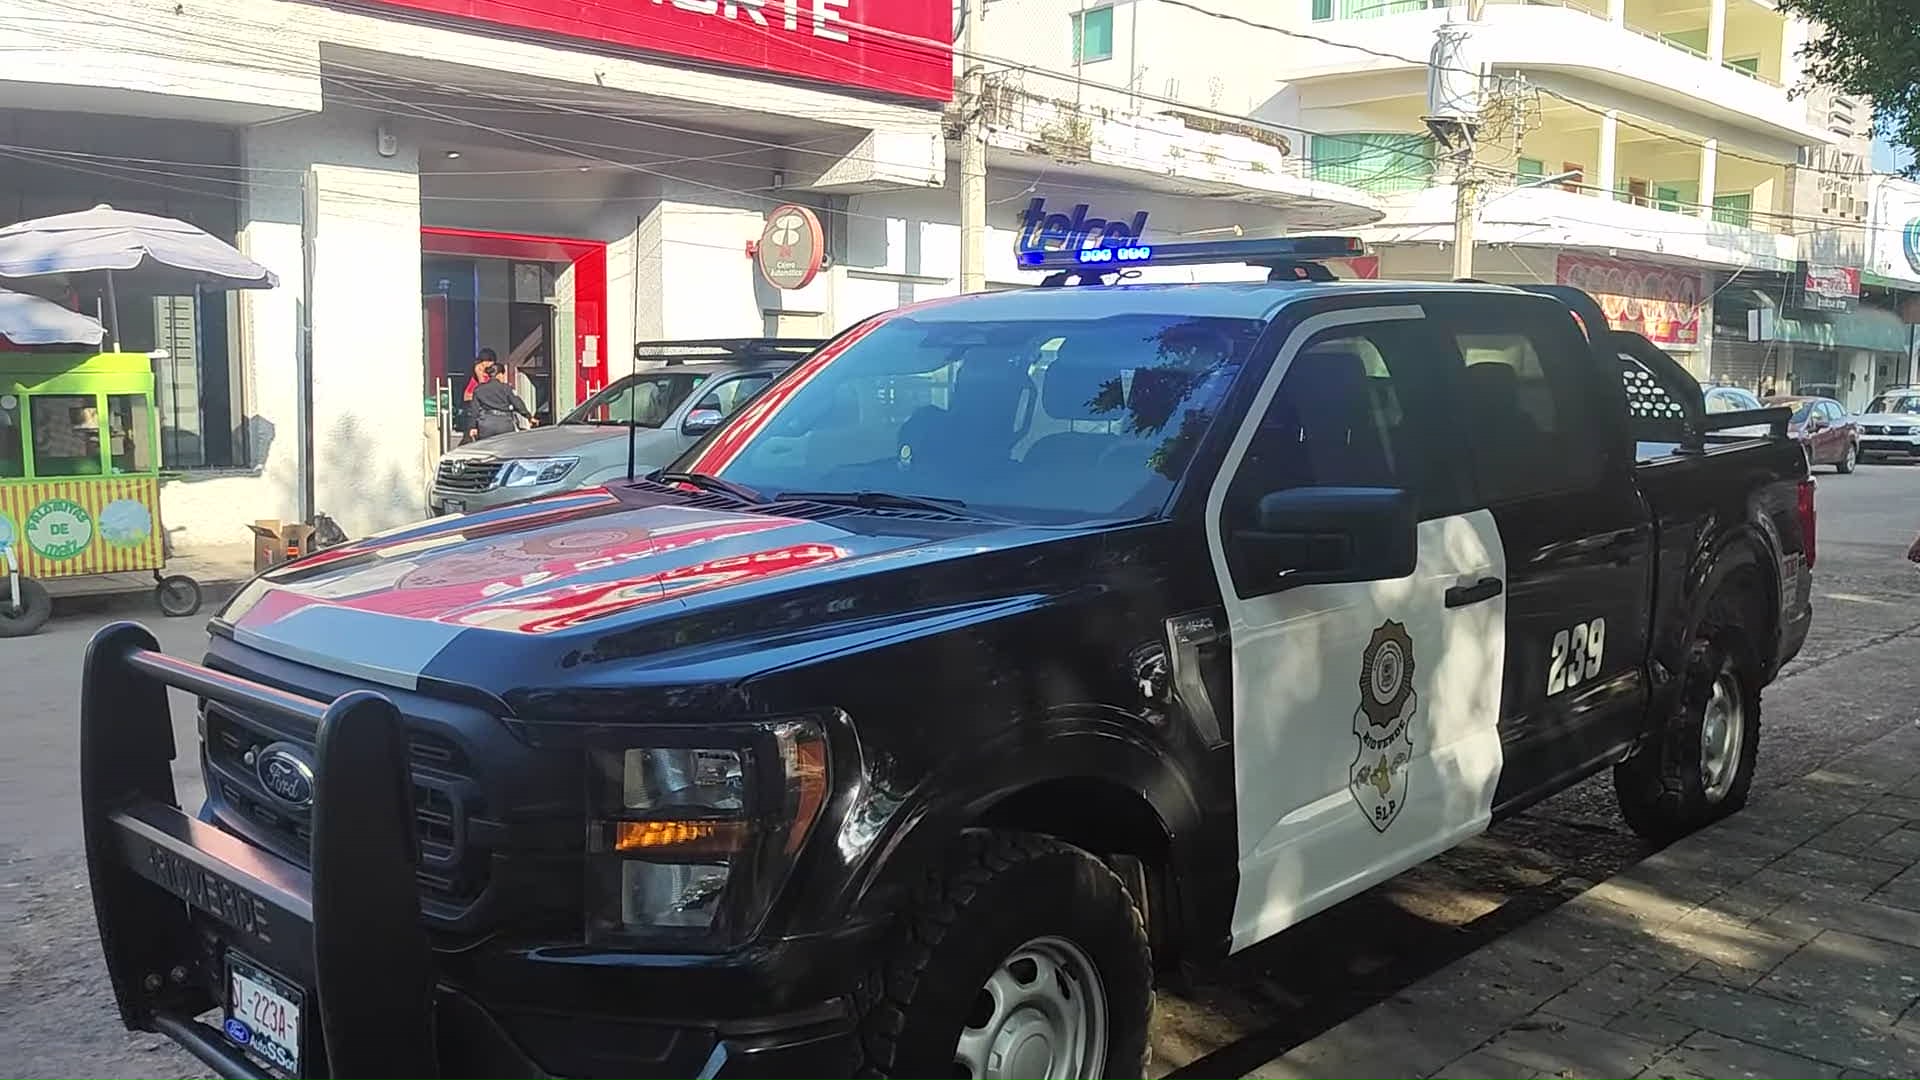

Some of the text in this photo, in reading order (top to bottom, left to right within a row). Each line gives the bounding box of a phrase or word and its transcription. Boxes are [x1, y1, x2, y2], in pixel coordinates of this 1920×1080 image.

[1020, 197, 1149, 250] telcel
[50, 523, 70, 535] DE
[1547, 617, 1605, 696] 239
[270, 762, 299, 798] Ford
[1375, 800, 1396, 821] SLP
